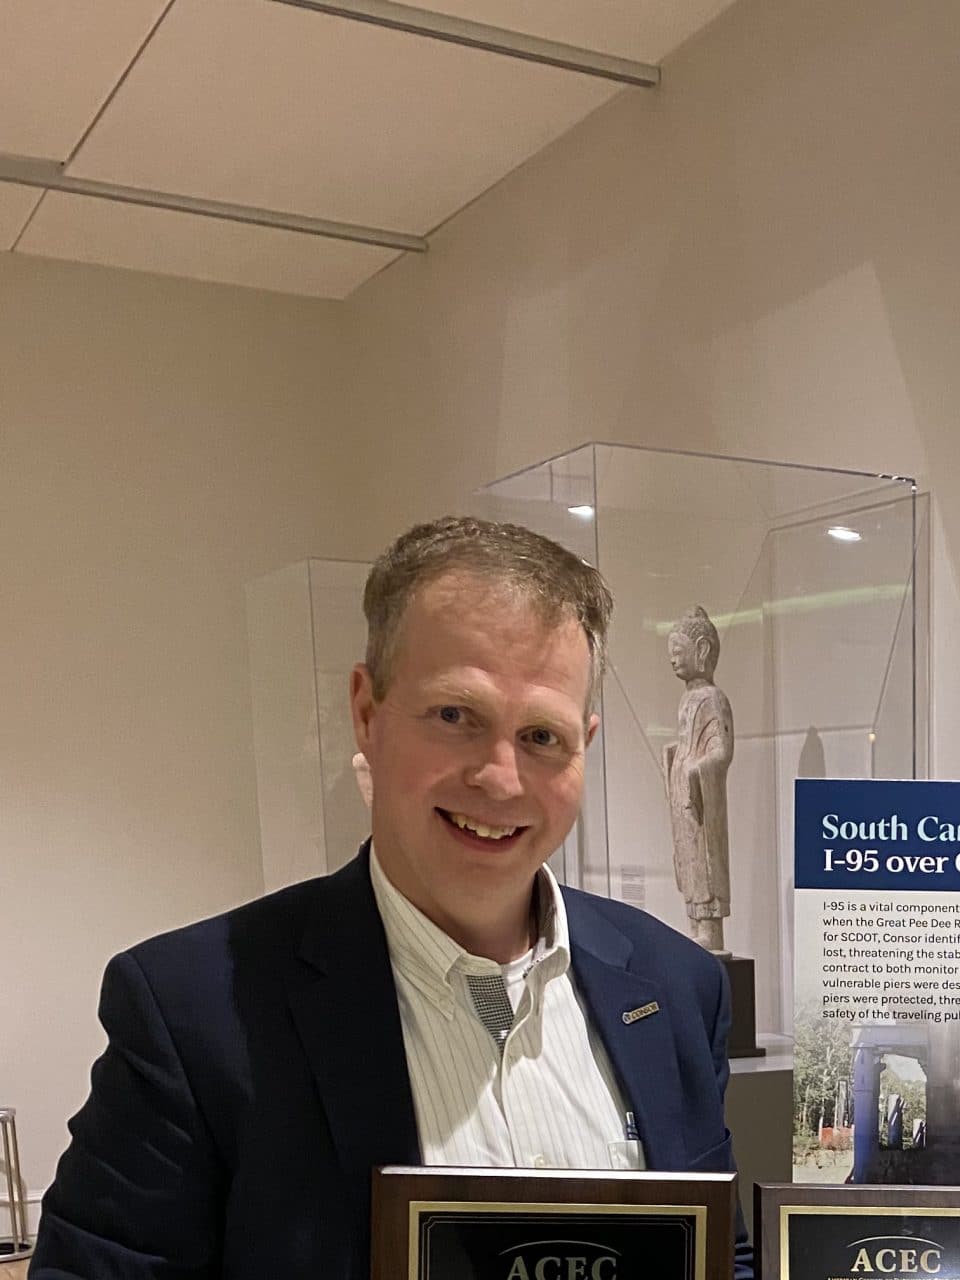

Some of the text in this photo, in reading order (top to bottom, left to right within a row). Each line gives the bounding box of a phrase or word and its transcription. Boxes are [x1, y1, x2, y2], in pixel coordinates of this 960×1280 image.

[822, 813, 907, 840] South
[823, 848, 879, 872] I-95
[886, 855, 949, 873] over
[823, 901, 844, 911] I-95
[847, 901, 857, 911] is
[859, 903, 866, 911] a
[868, 901, 893, 912] vital
[895, 903, 960, 915] component
[823, 1008, 856, 1022] safety
[858, 1008, 869, 1018] of
[871, 1009, 889, 1019] the
[892, 1009, 941, 1023] traveling
[850, 1248, 942, 1273] ACEC
